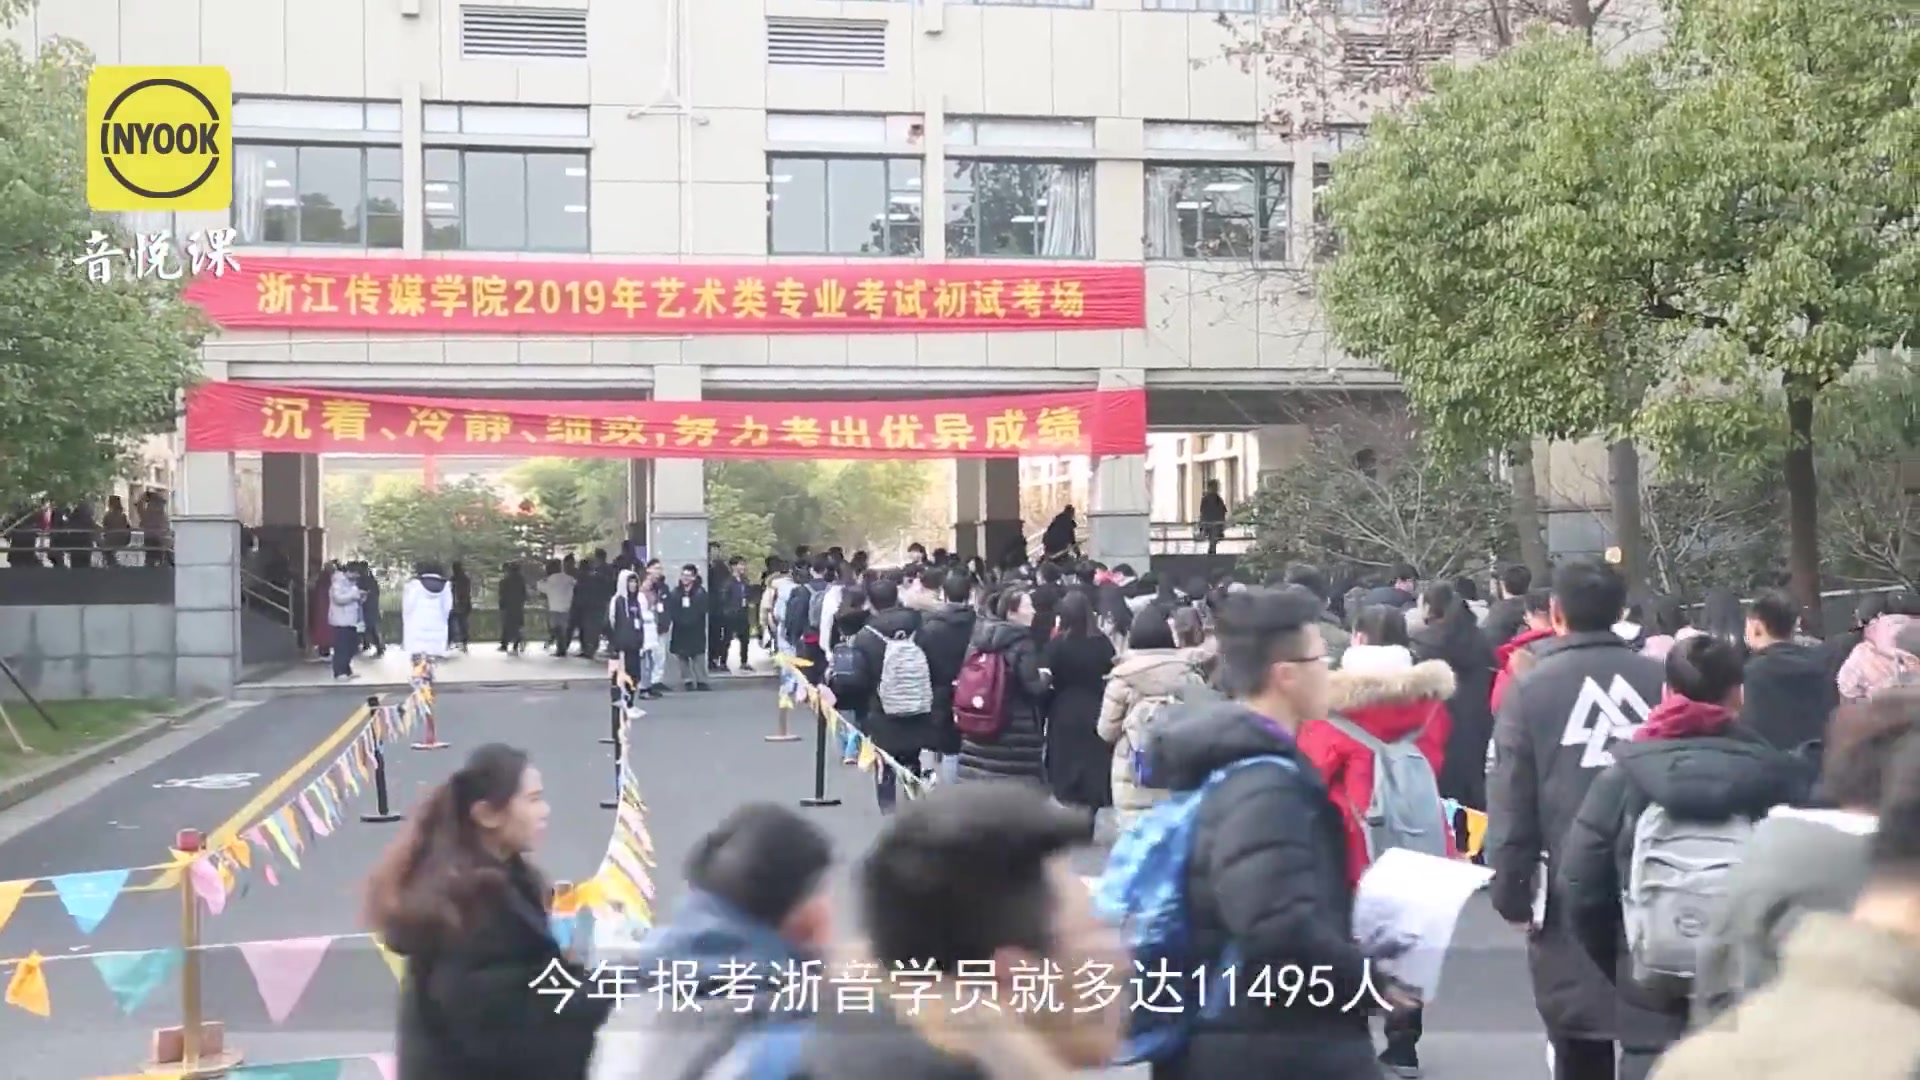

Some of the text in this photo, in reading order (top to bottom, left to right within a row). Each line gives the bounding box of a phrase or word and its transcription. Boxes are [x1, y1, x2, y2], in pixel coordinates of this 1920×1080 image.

[257, 273, 1085, 319] 浙江传媒学院2019年艺术类专业考试初试考场
